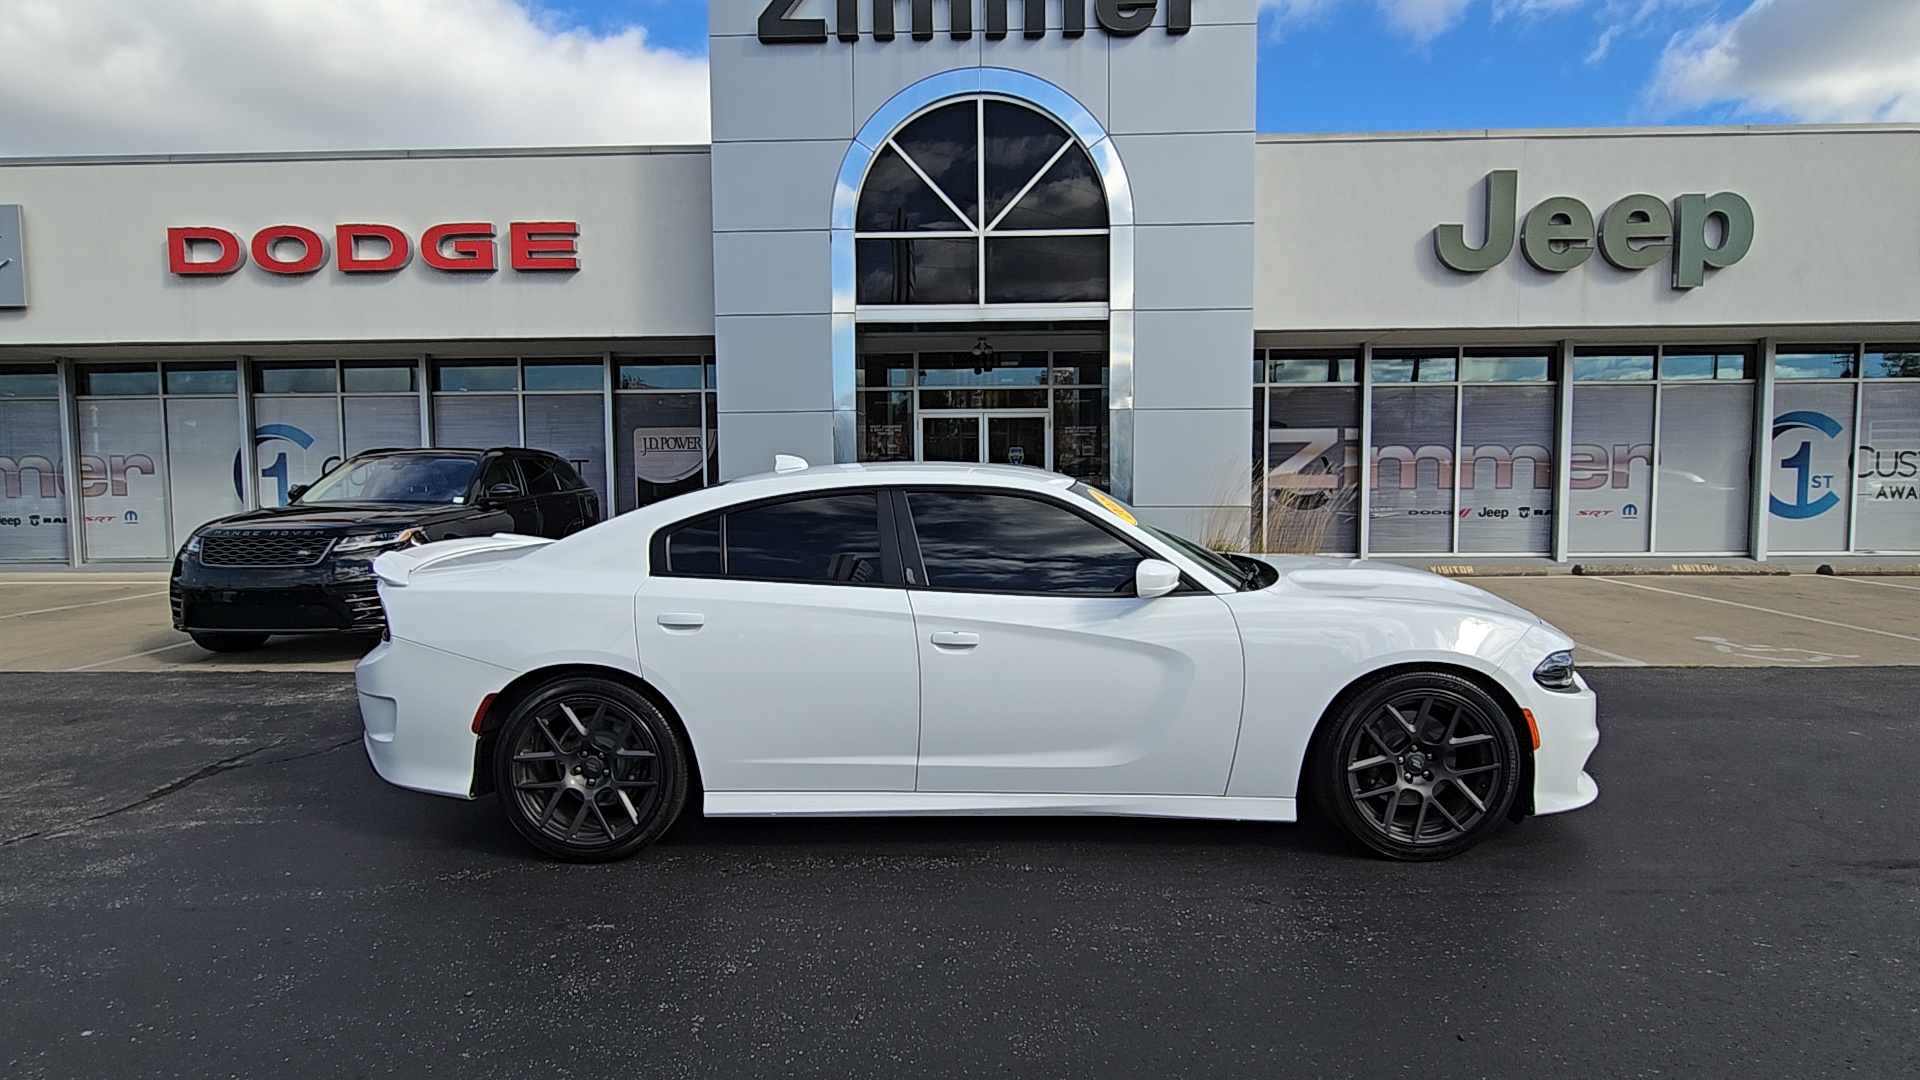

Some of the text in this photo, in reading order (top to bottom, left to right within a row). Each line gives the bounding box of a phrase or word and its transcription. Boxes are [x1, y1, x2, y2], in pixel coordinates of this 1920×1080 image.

[1434, 170, 1754, 290] Jeep
[167, 222, 580, 275] DODGE
[660, 436, 702, 450] POWER
[1267, 427, 1662, 490] Zimmer
[1848, 445, 1920, 478] CUS
[0, 516, 21, 527] eep
[1478, 507, 1509, 519] Jeep
[1430, 565, 1474, 574] VISITOR
